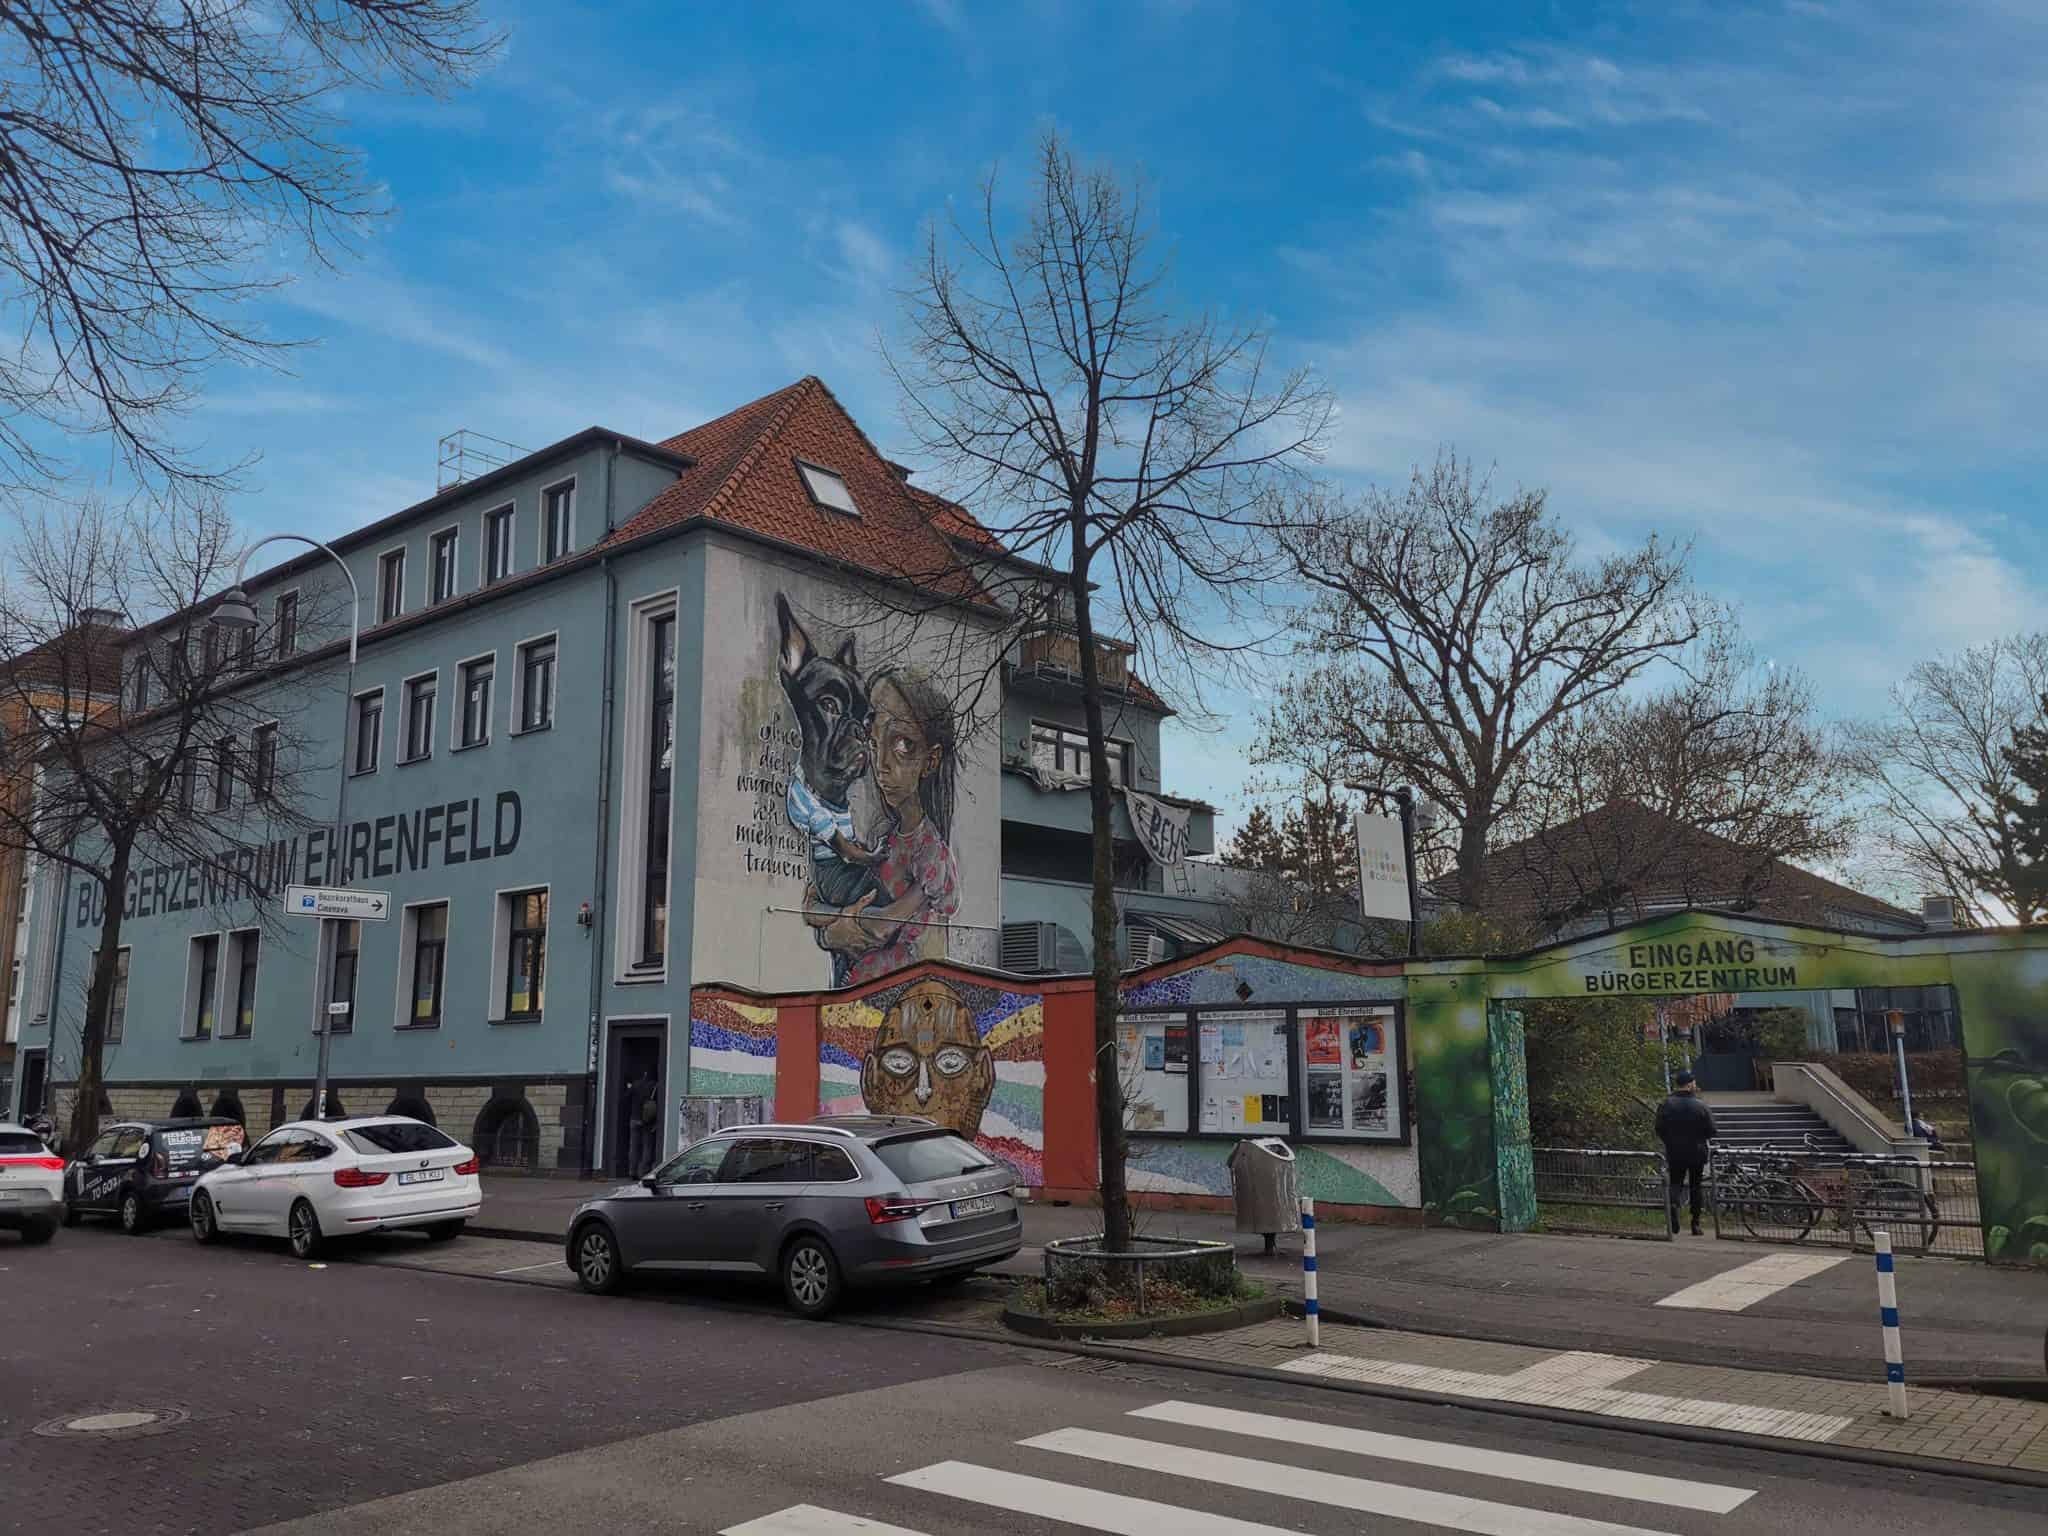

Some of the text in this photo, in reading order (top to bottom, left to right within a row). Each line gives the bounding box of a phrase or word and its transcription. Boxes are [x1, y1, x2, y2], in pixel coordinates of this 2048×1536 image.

[303, 790, 522, 887] EHRENFELD
[1629, 939, 1756, 969] EINGANG
[1584, 966, 1796, 993] BÜRGERZENTRUM
